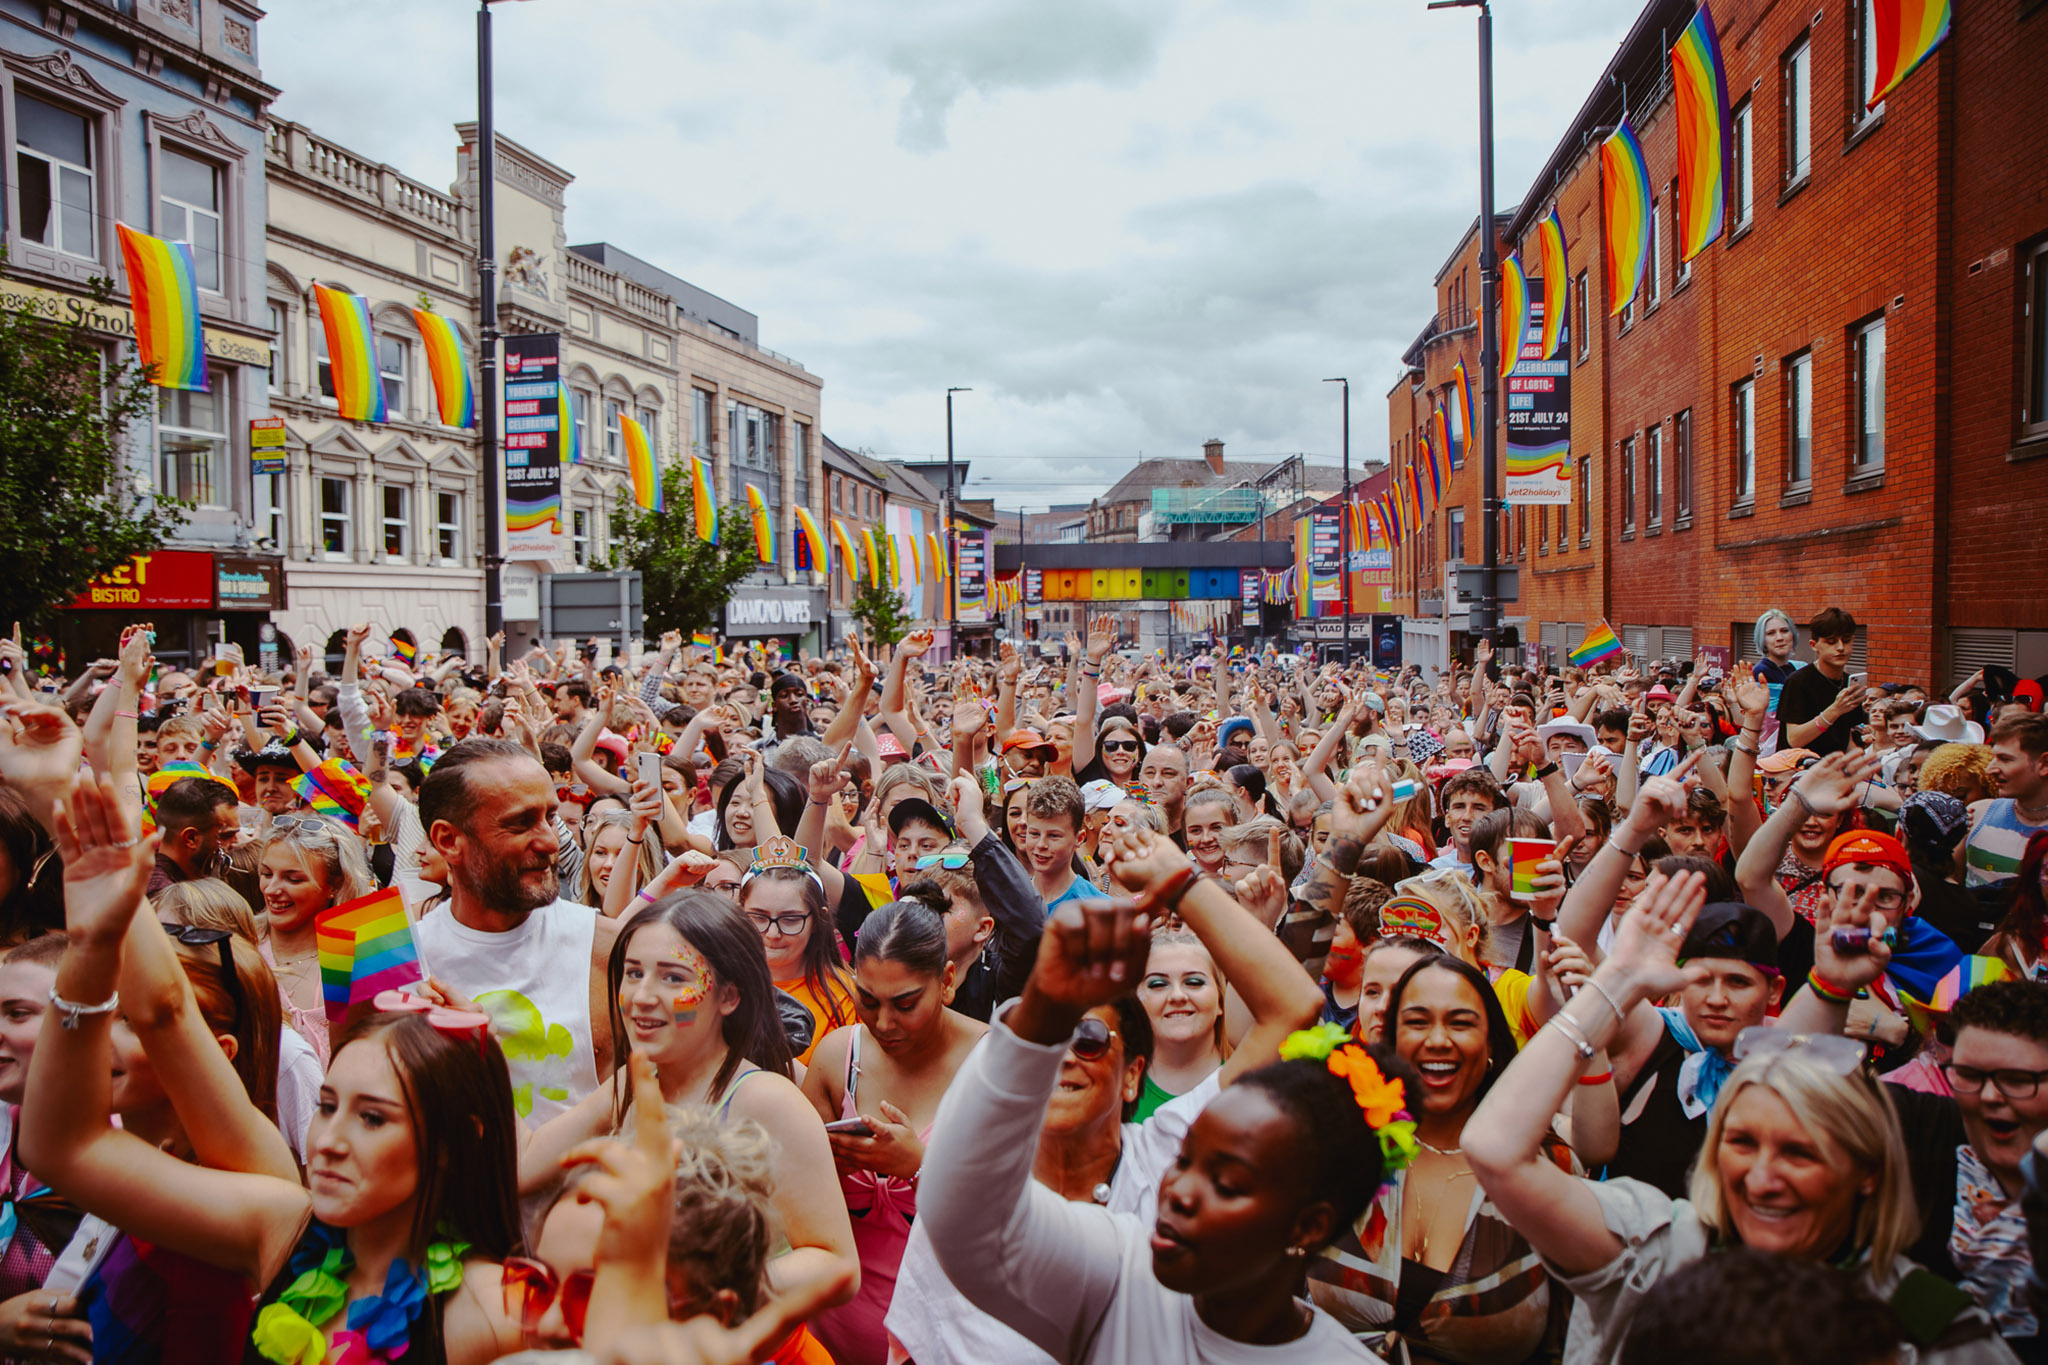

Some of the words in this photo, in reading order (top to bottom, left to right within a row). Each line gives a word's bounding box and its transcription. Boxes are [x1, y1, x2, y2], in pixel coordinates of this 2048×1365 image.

[1516, 362, 1565, 374] ELEBRATION
[1511, 380, 1522, 390] OF
[1523, 380, 1553, 390] LGBTQ+
[1512, 396, 1532, 406] LIFE!
[1508, 412, 1530, 424] 21ST
[1531, 412, 1554, 424] JULY
[1555, 412, 1569, 424] 24
[507, 468, 526, 480] 21ST
[526, 467, 547, 479] JULY
[547, 466, 560, 478] 24
[91, 587, 140, 603] BISTRO
[730, 599, 782, 624] DIAMOND
[782, 599, 811, 624] VAPES
[1318, 624, 1365, 633] VIADCT
